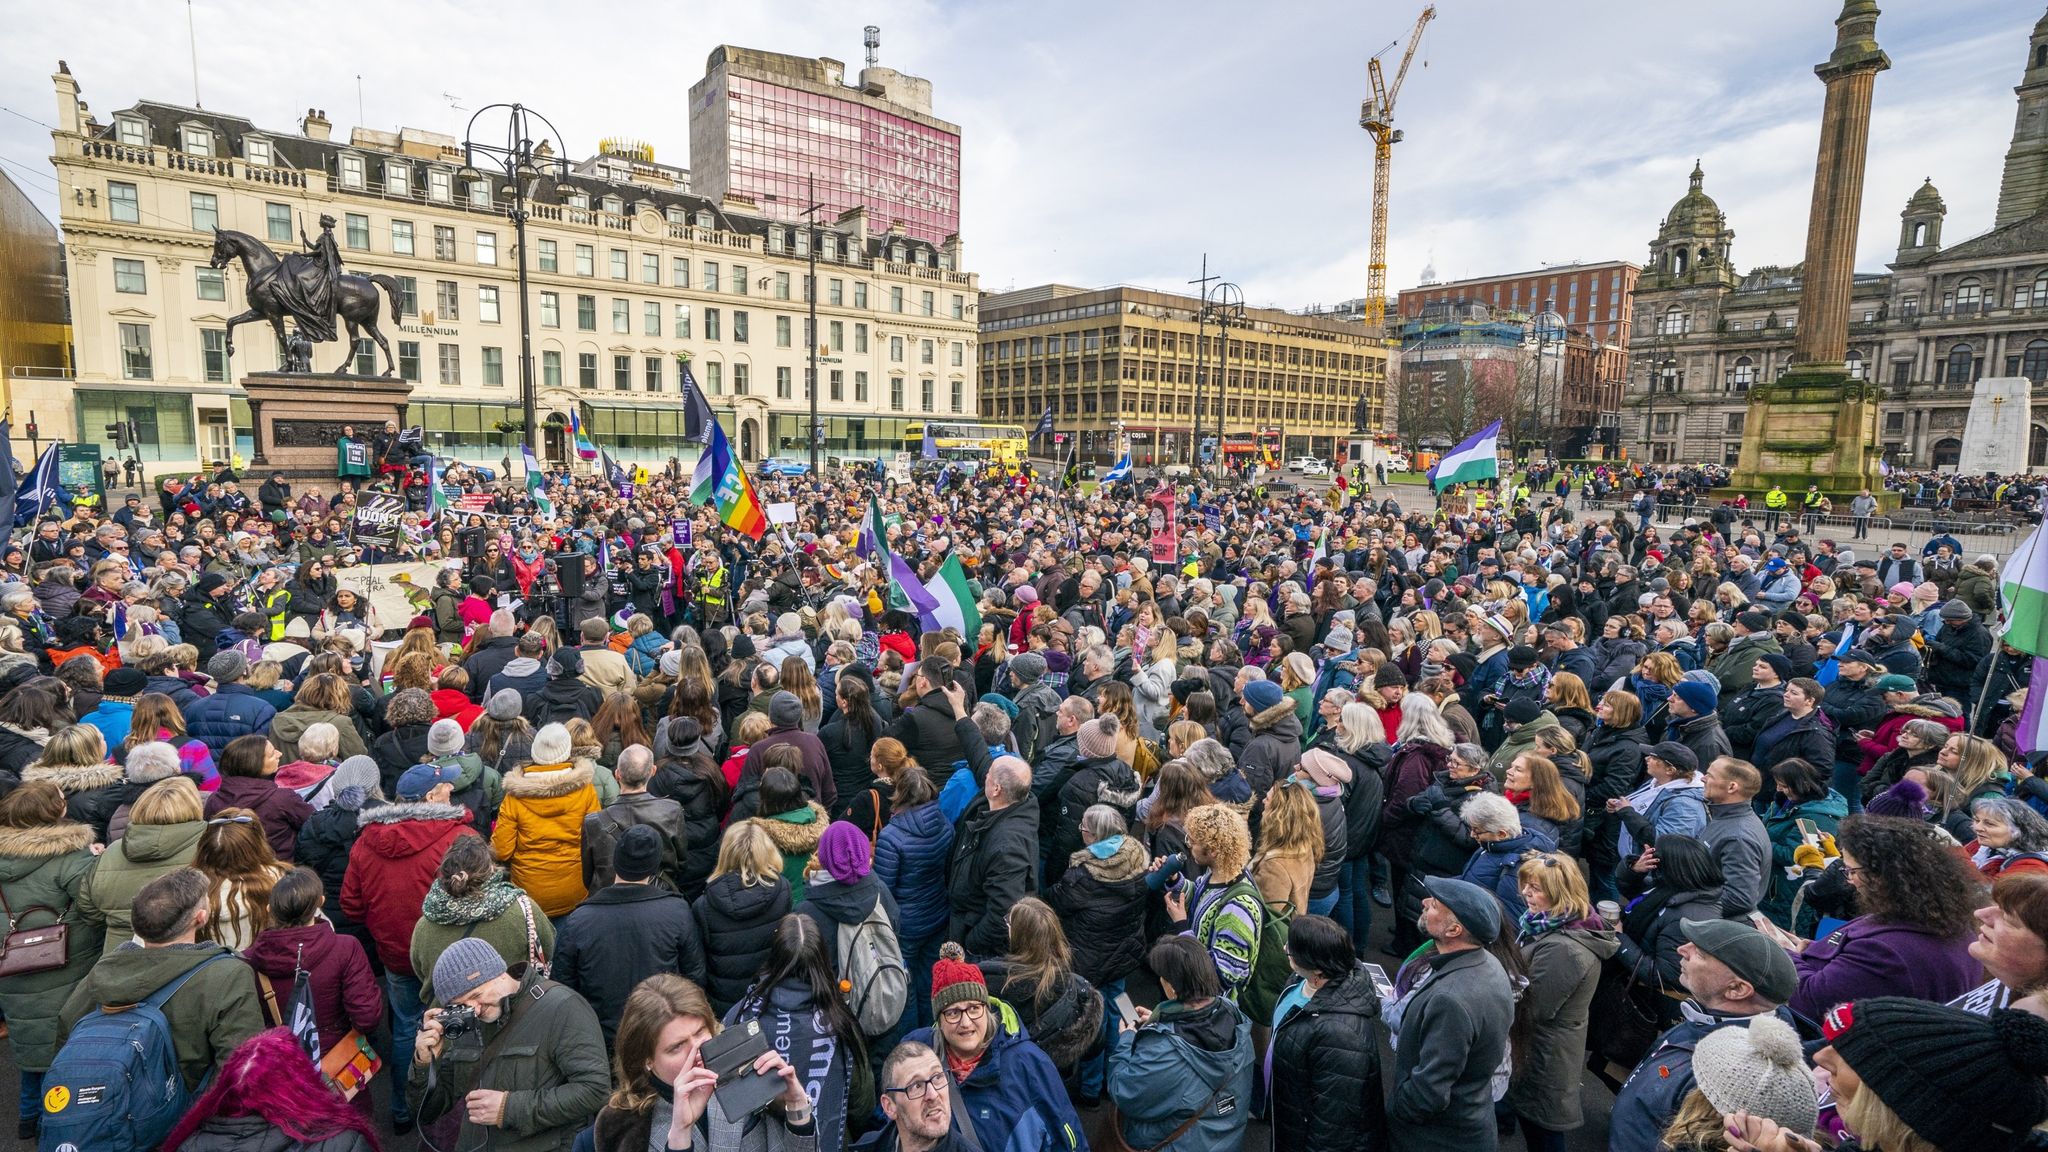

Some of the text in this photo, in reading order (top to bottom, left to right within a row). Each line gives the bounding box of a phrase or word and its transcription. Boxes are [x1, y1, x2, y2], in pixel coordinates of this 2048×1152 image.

[880, 121, 952, 160] PEOPLE
[897, 154, 952, 189] MAKE
[843, 169, 951, 214] GLASGOW
[399, 325, 458, 336] MILLENNIUM
[1455, 504, 1467, 514] NO
